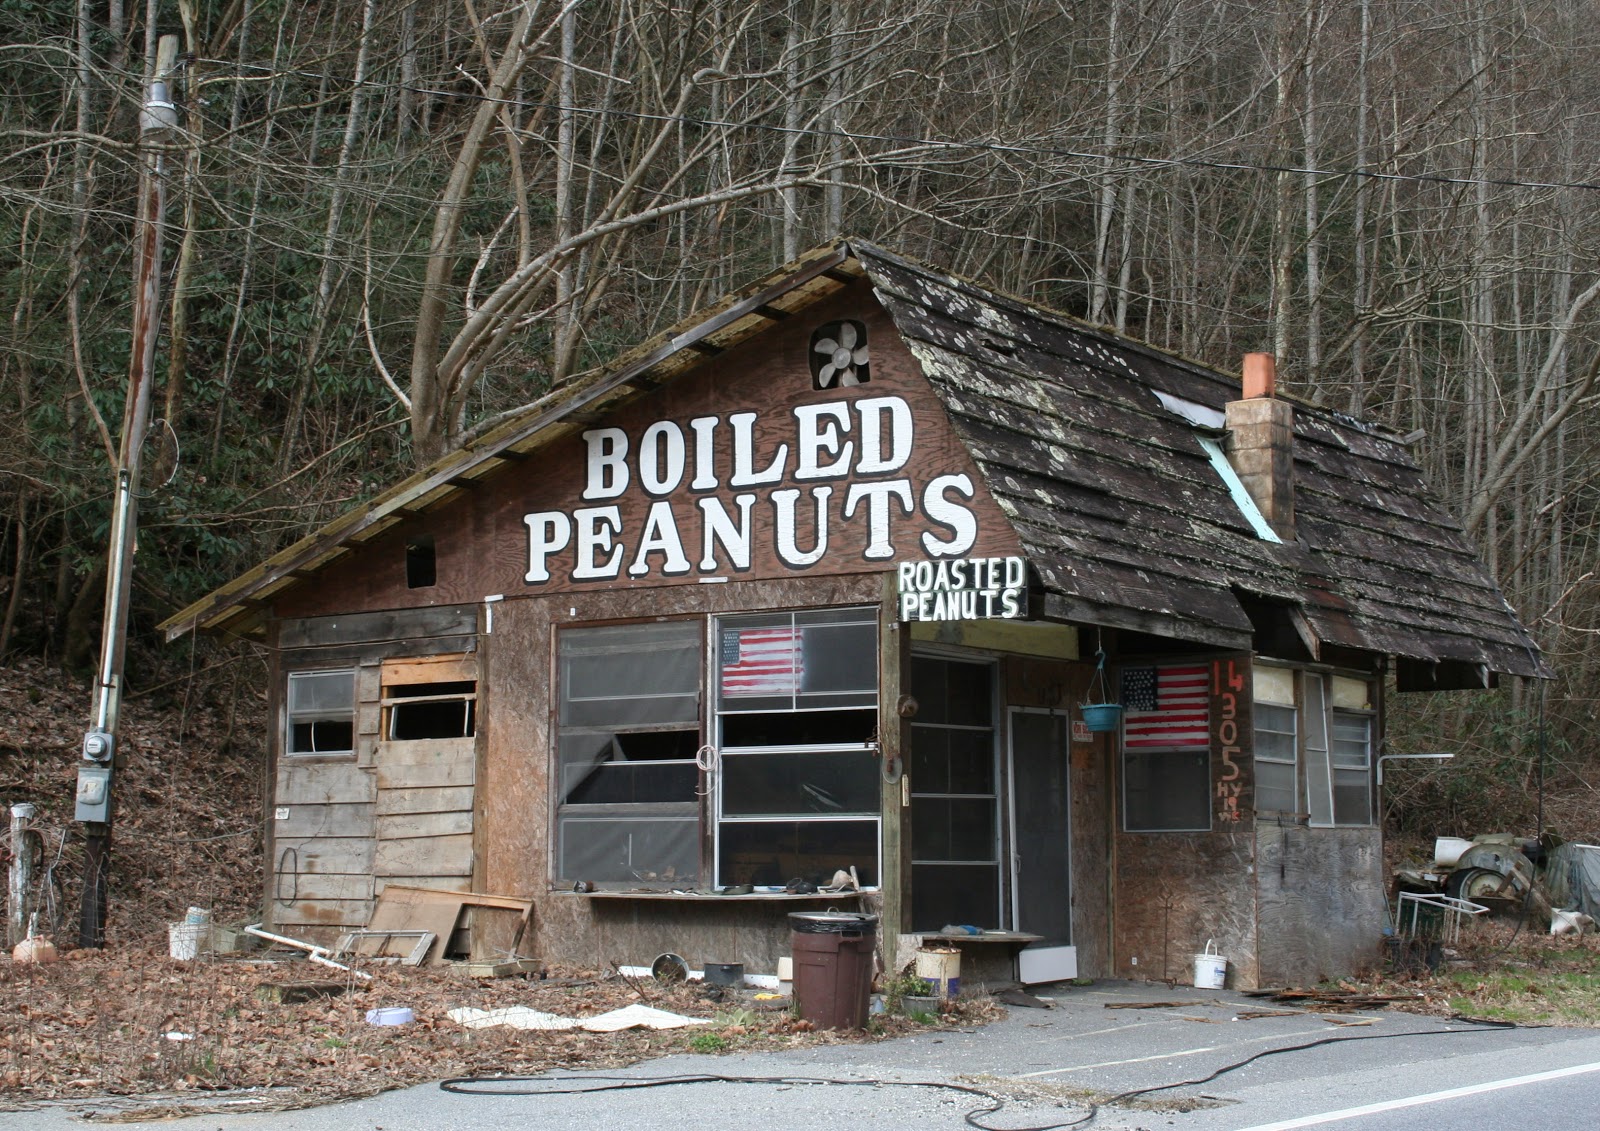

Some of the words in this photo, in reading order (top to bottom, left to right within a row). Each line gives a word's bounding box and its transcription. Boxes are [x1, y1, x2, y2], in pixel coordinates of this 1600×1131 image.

[582, 396, 913, 500] BOILED
[523, 474, 978, 584] PEANUTS
[899, 556, 1025, 592] ROASTED
[902, 588, 1020, 622] PEANUTS
